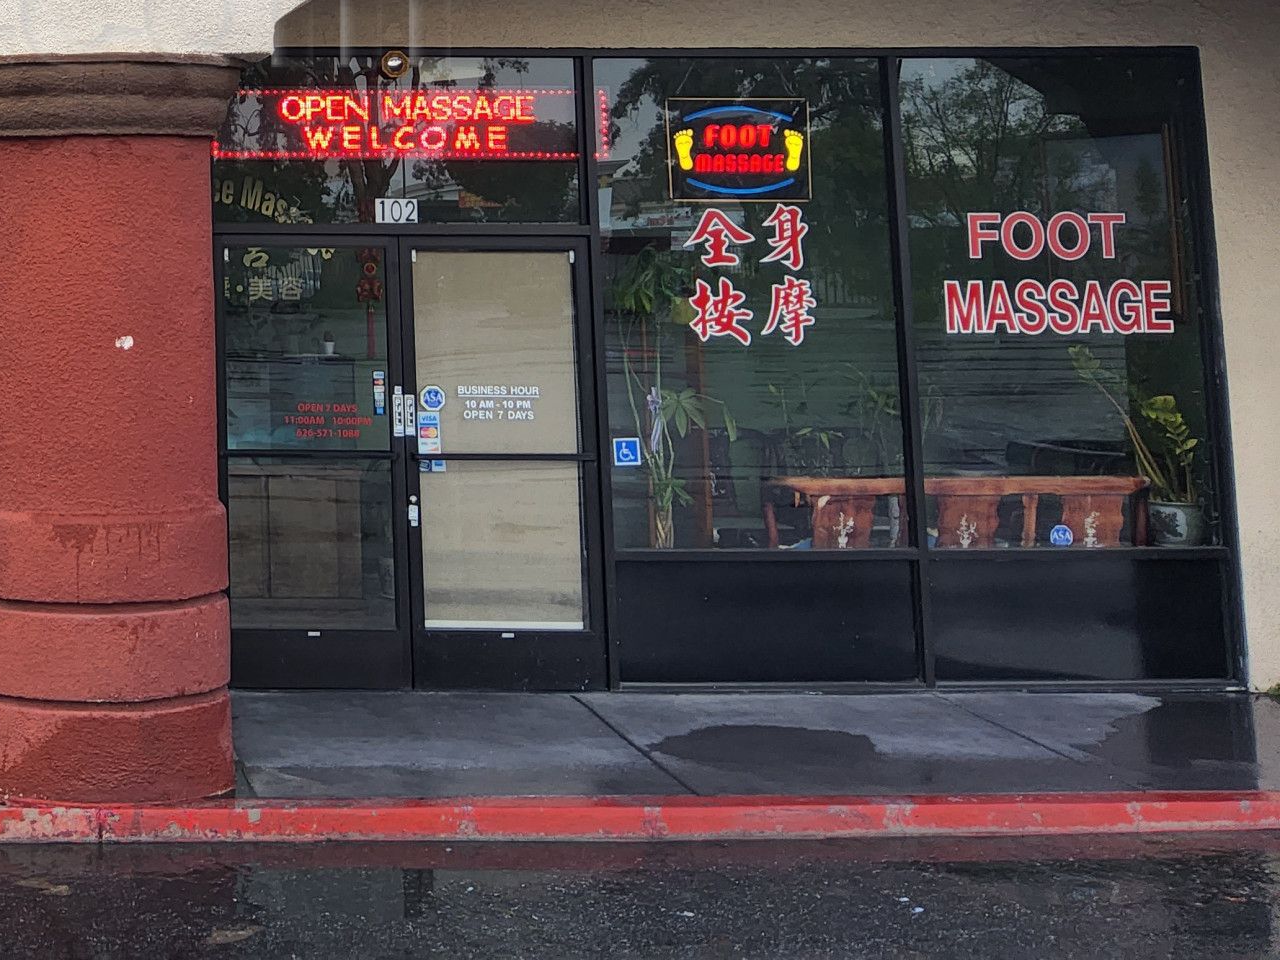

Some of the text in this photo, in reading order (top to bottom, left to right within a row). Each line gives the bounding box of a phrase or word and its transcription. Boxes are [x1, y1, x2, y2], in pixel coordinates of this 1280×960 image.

[281, 95, 535, 121] OPEN MASSAGE
[304, 125, 508, 150] WELCOME
[704, 124, 774, 148] FOOT
[694, 153, 785, 174] MASSAGE
[379, 200, 416, 222] 102
[683, 203, 808, 271] 全身
[967, 211, 1126, 261] FOOT
[689, 275, 817, 346] 按摩
[944, 279, 1175, 335] MASSAGE
[457, 385, 539, 395] BUSINESS HOUR
[297, 404, 323, 412] OPEN
[333, 404, 357, 413] DAYS
[463, 411, 534, 419] OPEN 7 DAYS
[465, 400, 476, 408] 10
[479, 400, 494, 408] AM
